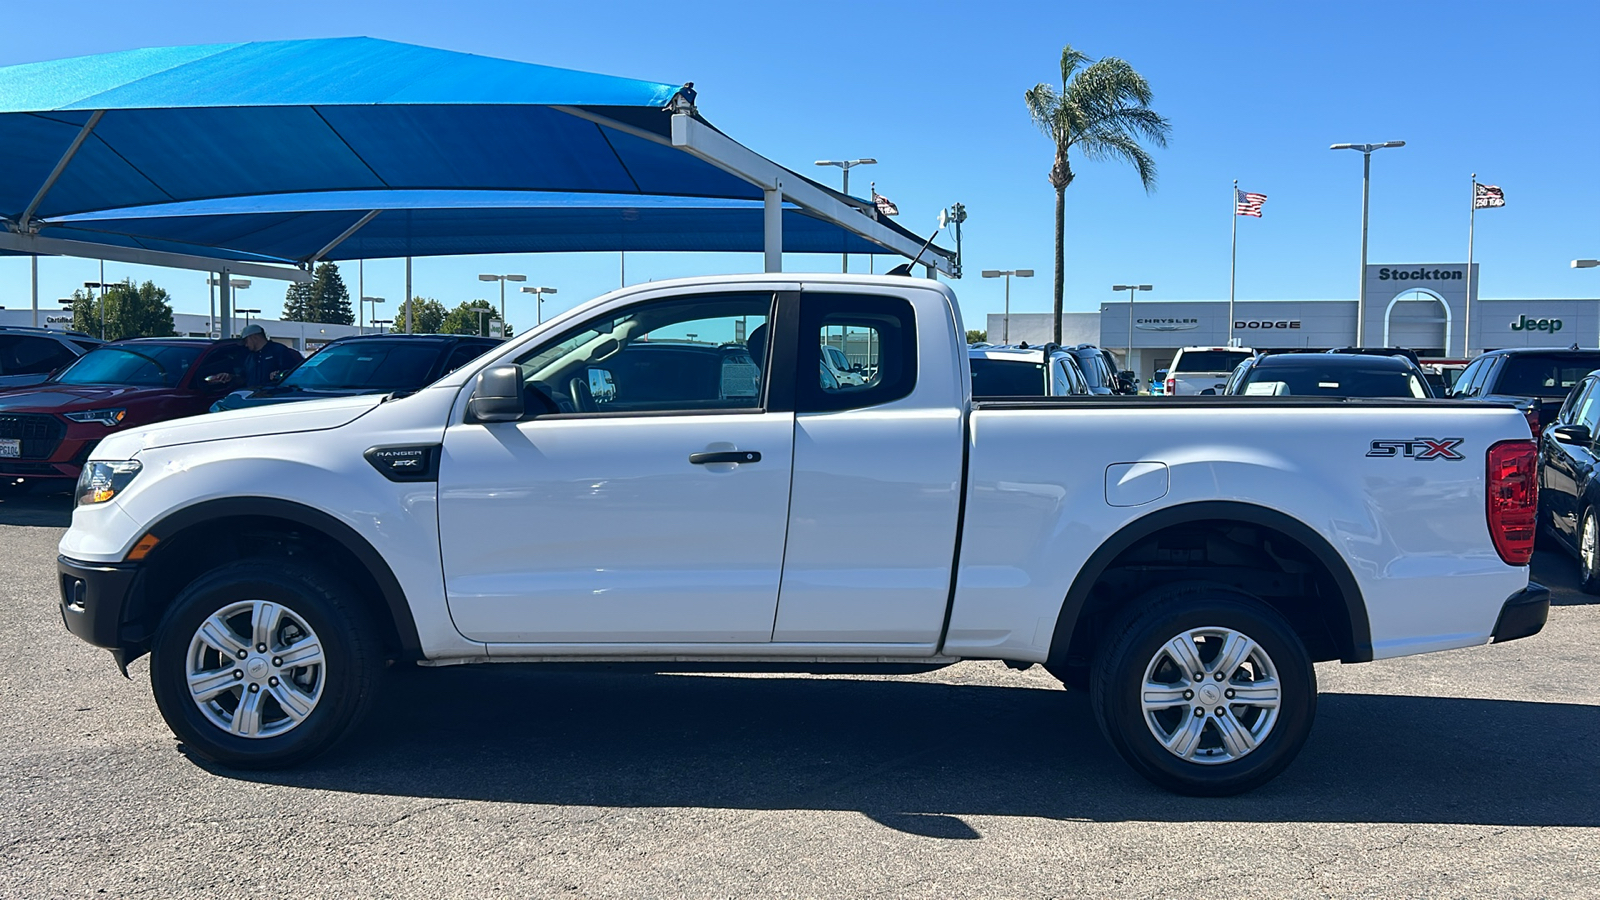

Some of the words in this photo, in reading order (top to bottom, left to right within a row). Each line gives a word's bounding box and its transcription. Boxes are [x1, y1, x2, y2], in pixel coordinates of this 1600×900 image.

[1379, 268, 1463, 281] Stockton
[1234, 321, 1301, 329] DODGE
[1511, 315, 1563, 334] Jeep
[1365, 437, 1466, 462] STX
